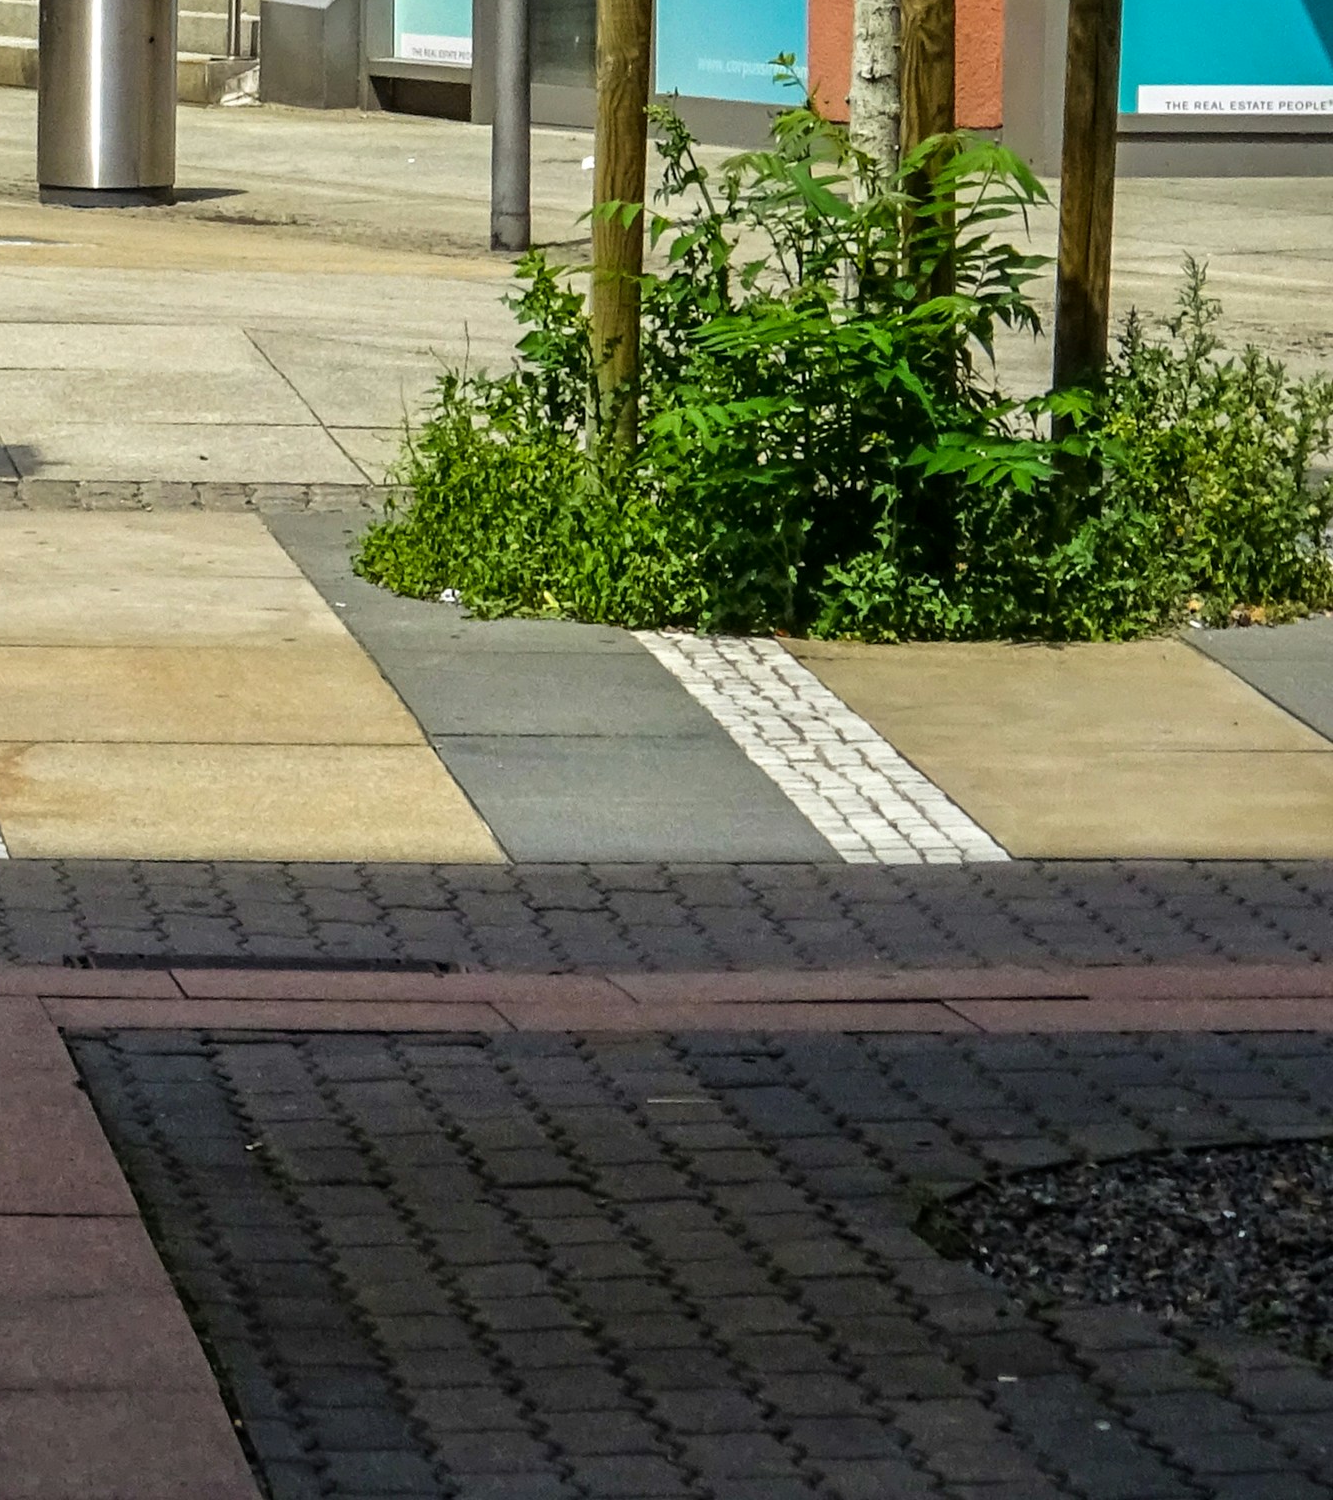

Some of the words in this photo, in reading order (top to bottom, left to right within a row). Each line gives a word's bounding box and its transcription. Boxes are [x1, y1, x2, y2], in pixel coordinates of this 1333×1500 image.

[1165, 101, 1189, 111] THE
[1194, 101, 1225, 111] REAL
[1230, 101, 1273, 111] ESTATE
